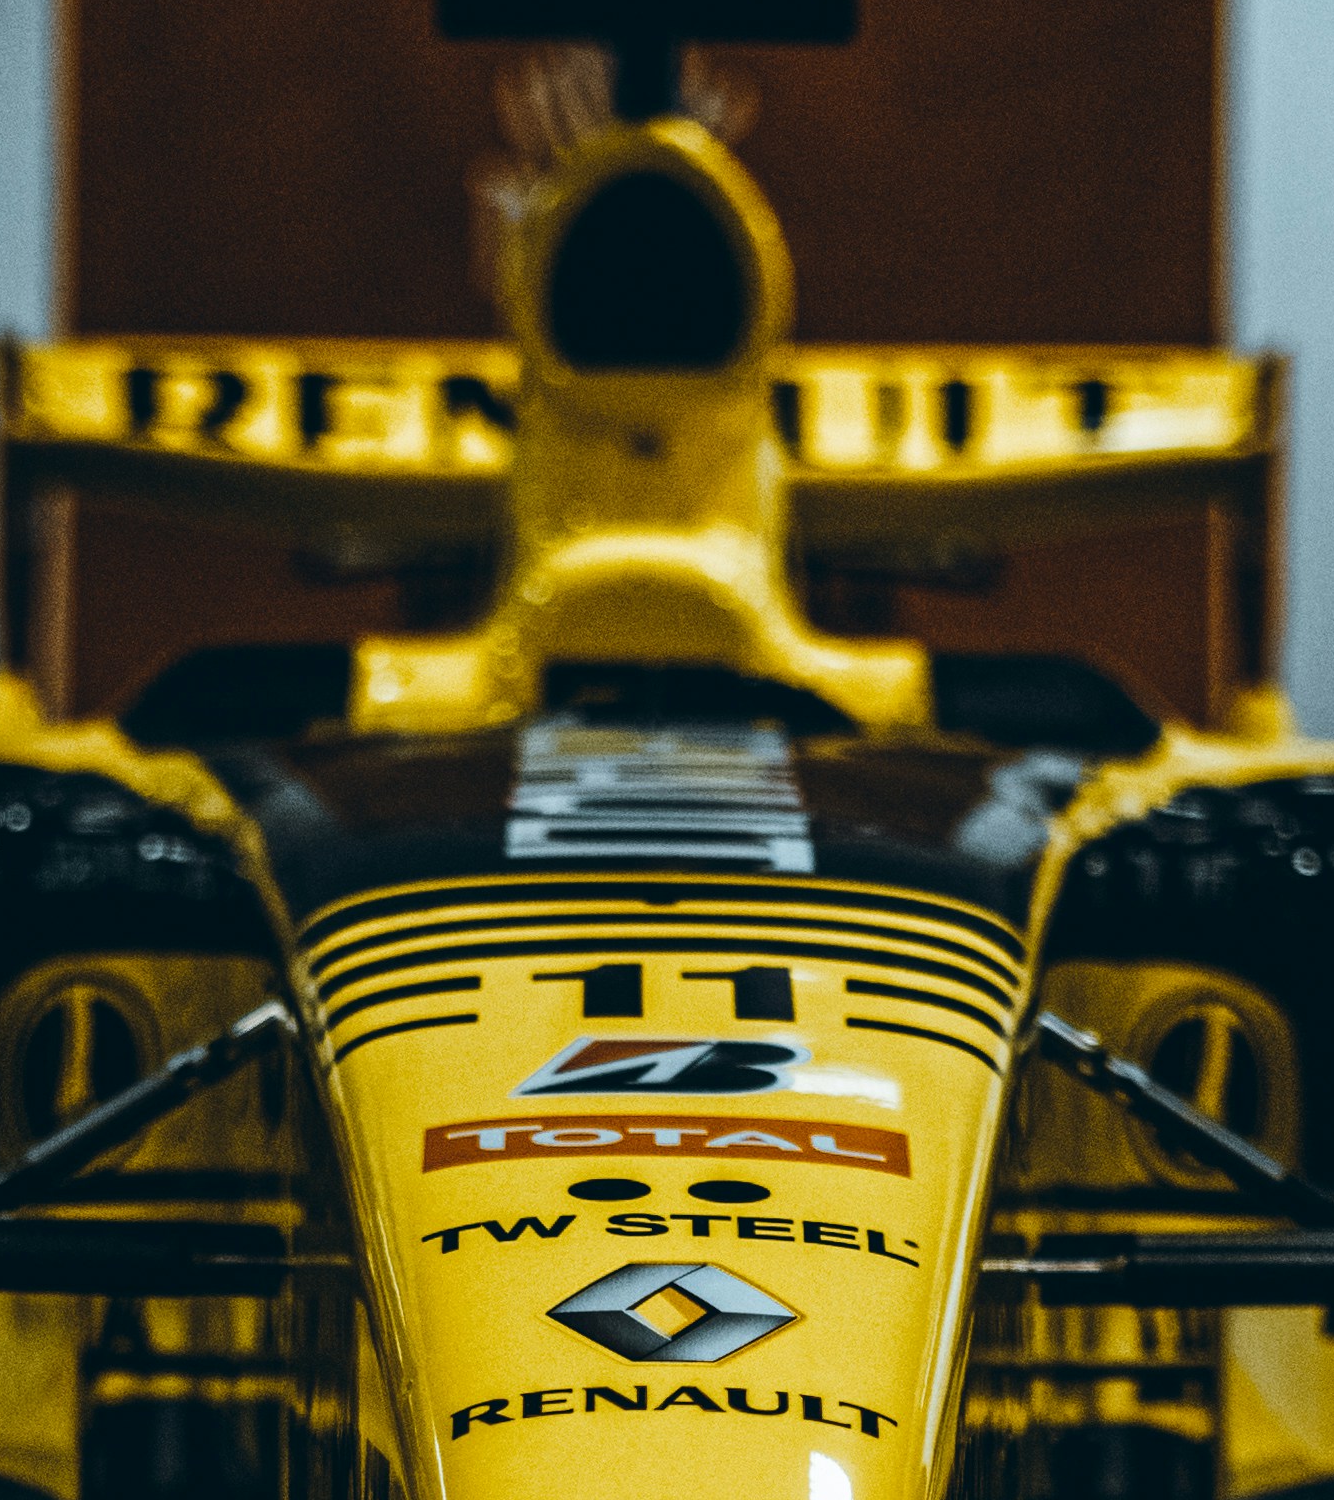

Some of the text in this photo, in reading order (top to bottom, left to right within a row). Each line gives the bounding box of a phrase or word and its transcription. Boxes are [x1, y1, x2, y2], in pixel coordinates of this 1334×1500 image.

[531, 962, 796, 1023] 11
[446, 1125, 889, 1164] TOTAL
[421, 1213, 920, 1268] TW STEEL
[451, 1385, 898, 1441] RENAULT
